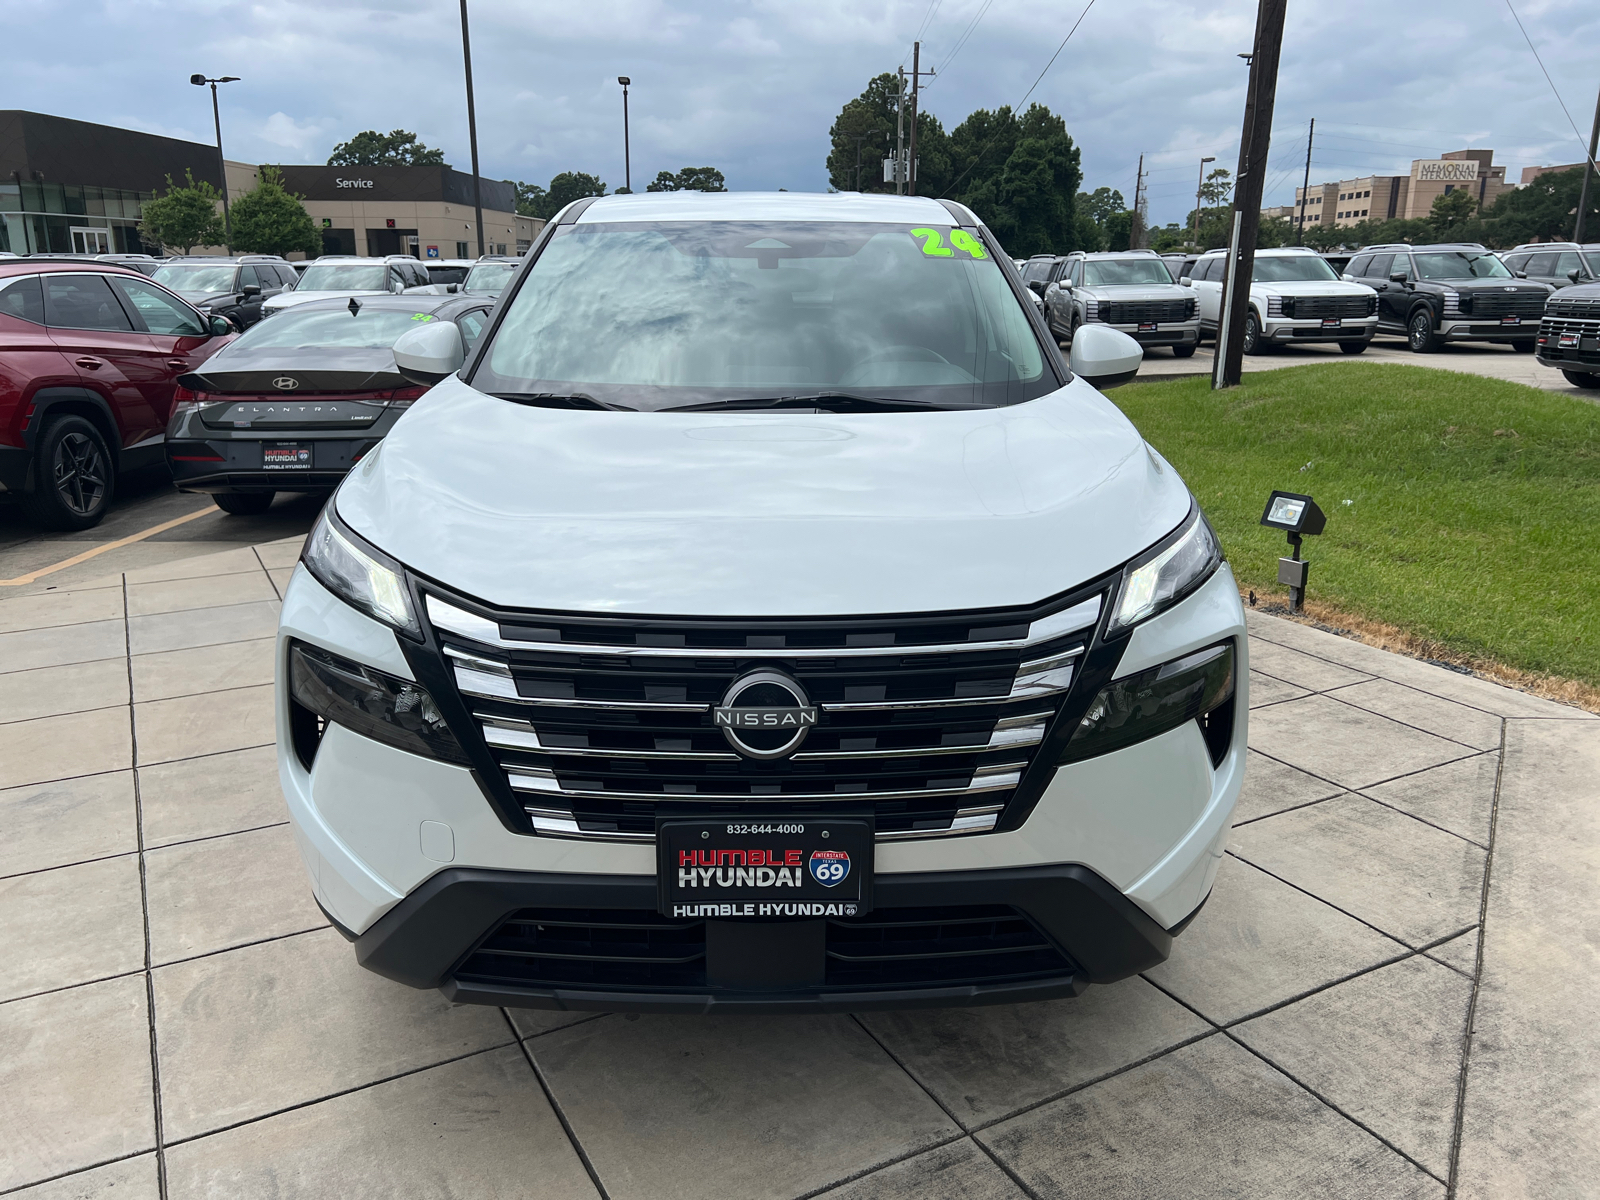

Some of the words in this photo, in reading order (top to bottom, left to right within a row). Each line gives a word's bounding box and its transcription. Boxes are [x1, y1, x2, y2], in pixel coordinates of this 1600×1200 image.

[1422, 163, 1475, 172] MEMORIAL
[1420, 171, 1475, 180] HERMANN
[335, 177, 374, 189] Service
[910, 227, 988, 259] 24
[411, 313, 433, 322] 24
[716, 711, 815, 726] NISSAN
[726, 824, 805, 834] 832-644-4000
[678, 849, 803, 867] HUMBLE
[678, 867, 802, 888] HYUNDAI
[816, 863, 844, 880] 69
[673, 904, 755, 917] HUMBLE
[759, 903, 844, 916] HYUNDAI
